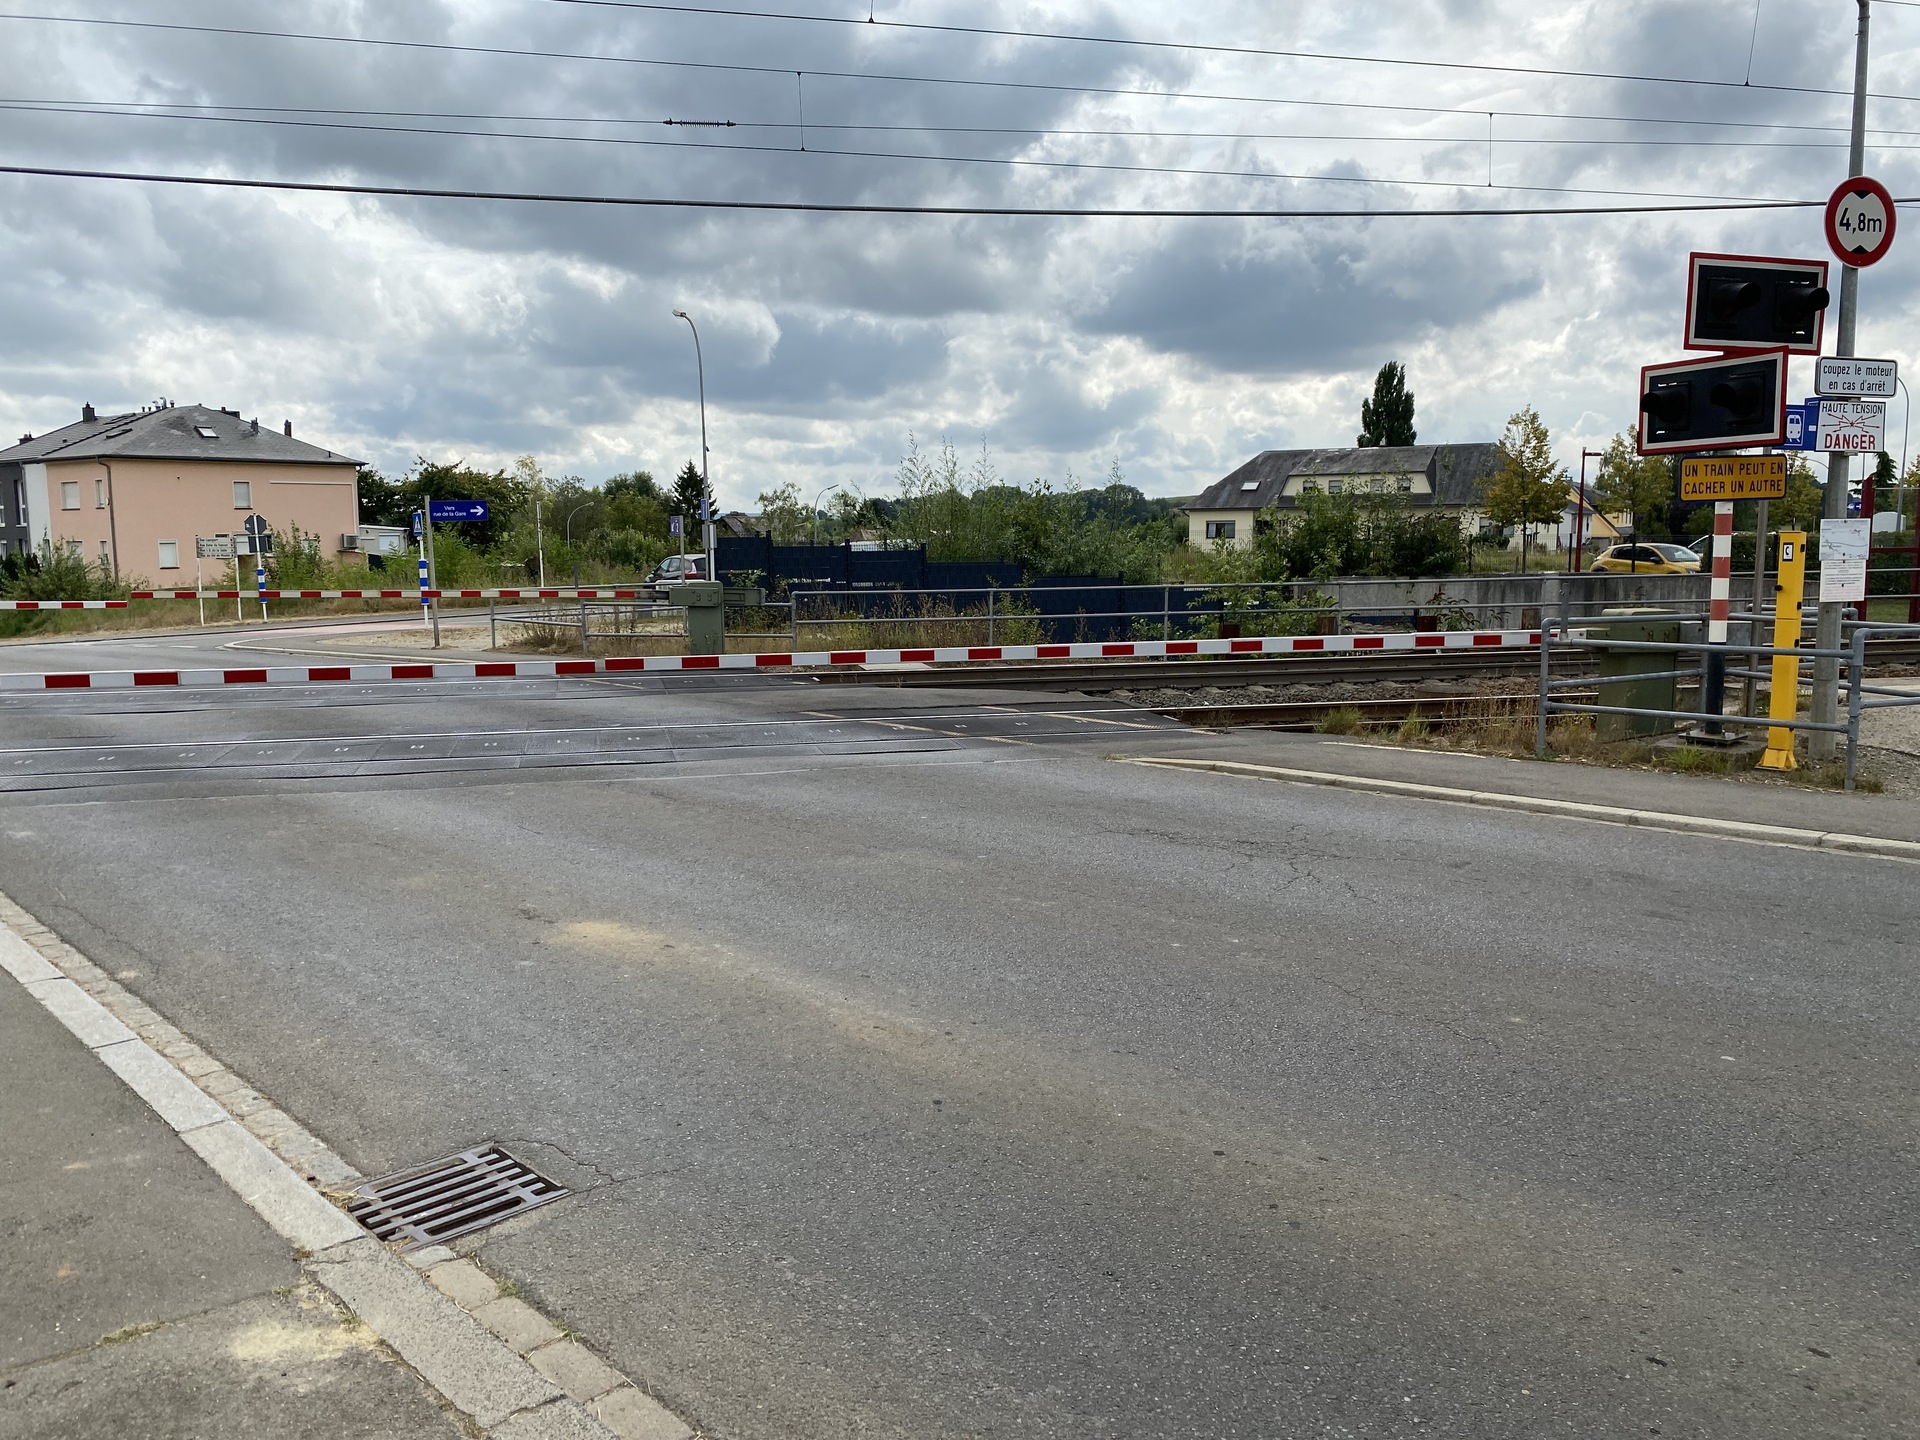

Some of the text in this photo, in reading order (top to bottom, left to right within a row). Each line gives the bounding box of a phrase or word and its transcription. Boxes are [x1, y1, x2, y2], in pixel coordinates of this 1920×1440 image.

[1839, 208, 1882, 234] 4,8m
[1823, 364, 1893, 377] coupez le moteur
[1829, 380, 1886, 391] en cas d'arrêt
[1822, 403, 1883, 414] HAUTE TENSION
[1824, 434, 1876, 450] DANGER
[1684, 462, 1783, 477] UN TRAIN PEUT EN
[1684, 479, 1782, 495] CACHER UN AUTRE
